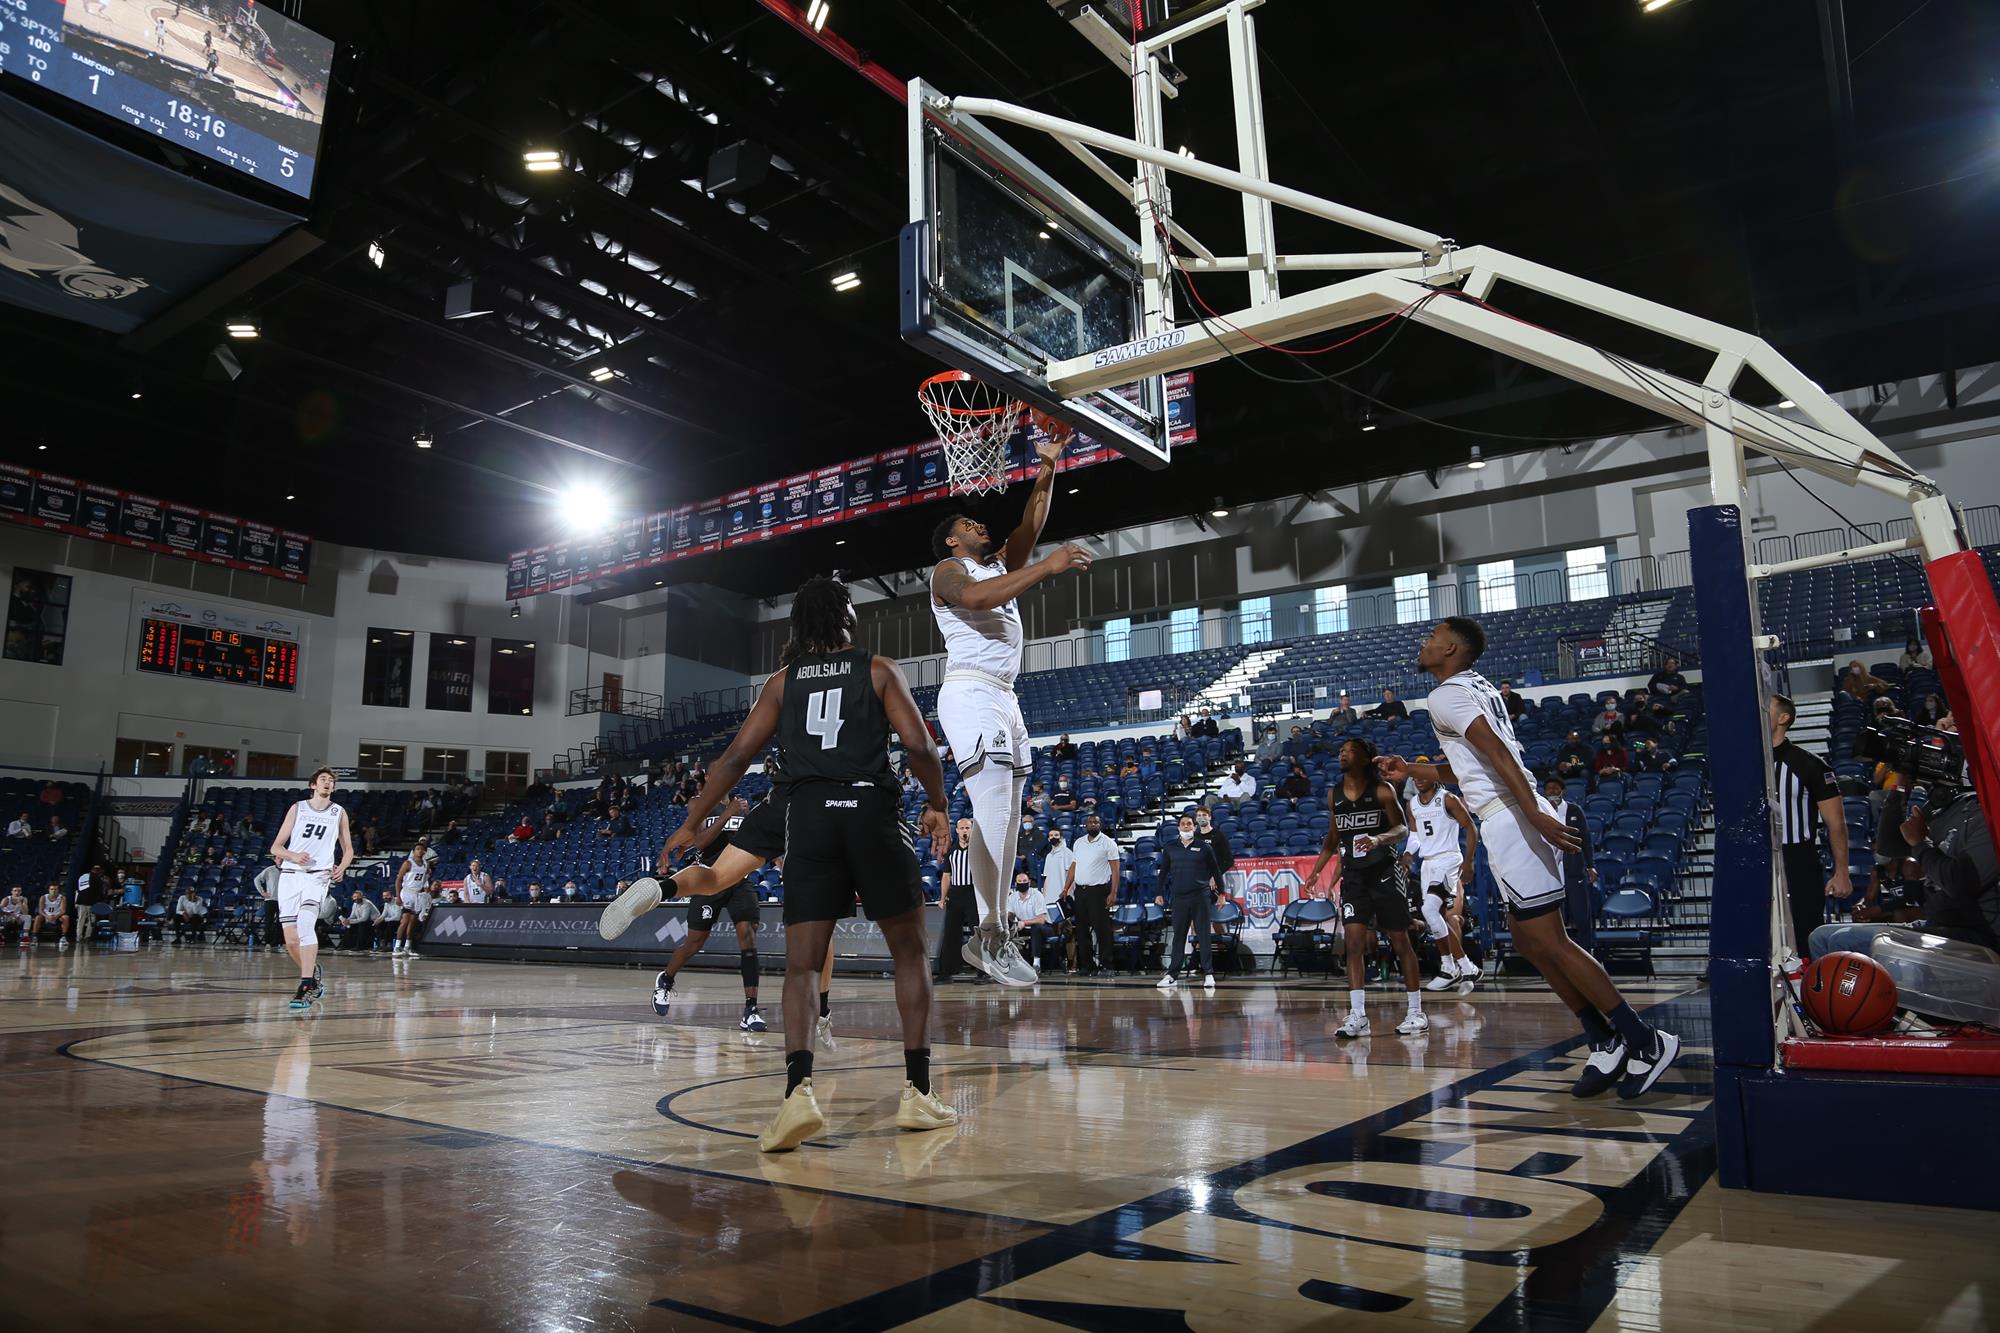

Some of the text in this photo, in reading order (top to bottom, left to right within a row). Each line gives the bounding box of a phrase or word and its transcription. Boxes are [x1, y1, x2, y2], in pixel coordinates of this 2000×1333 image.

[20, 16, 60, 42] 3PT%
[27, 35, 52, 53] 100
[27, 54, 47, 70] TO
[72, 52, 115, 76] SAMFORD
[32, 71, 41, 81] 0
[88, 74, 100, 95] 1
[121, 104, 145, 119] FOULS
[167, 100, 226, 138] 18:16
[184, 128, 201, 141] 1ST
[216, 145, 238, 159] FOULS
[278, 145, 299, 158] UNCG
[280, 157, 295, 178] 5
[1095, 330, 1185, 368] SAMFORD
[920, 449, 940, 459] SOCCER
[1078, 455, 1096, 463] 2020
[850, 466, 872, 476] BASEBALL
[0, 476, 29, 487] LLEYBALL
[86, 496, 115, 507] FOOTBALL
[796, 662, 851, 680] ABDULSALAM
[806, 687, 845, 750] 4
[825, 800, 858, 808] SPARTANS
[1335, 811, 1381, 831] UNCG
[1423, 821, 1434, 836] 5
[302, 823, 328, 840] 34
[470, 919, 514, 929] MELD
[710, 922, 767, 932] MED
